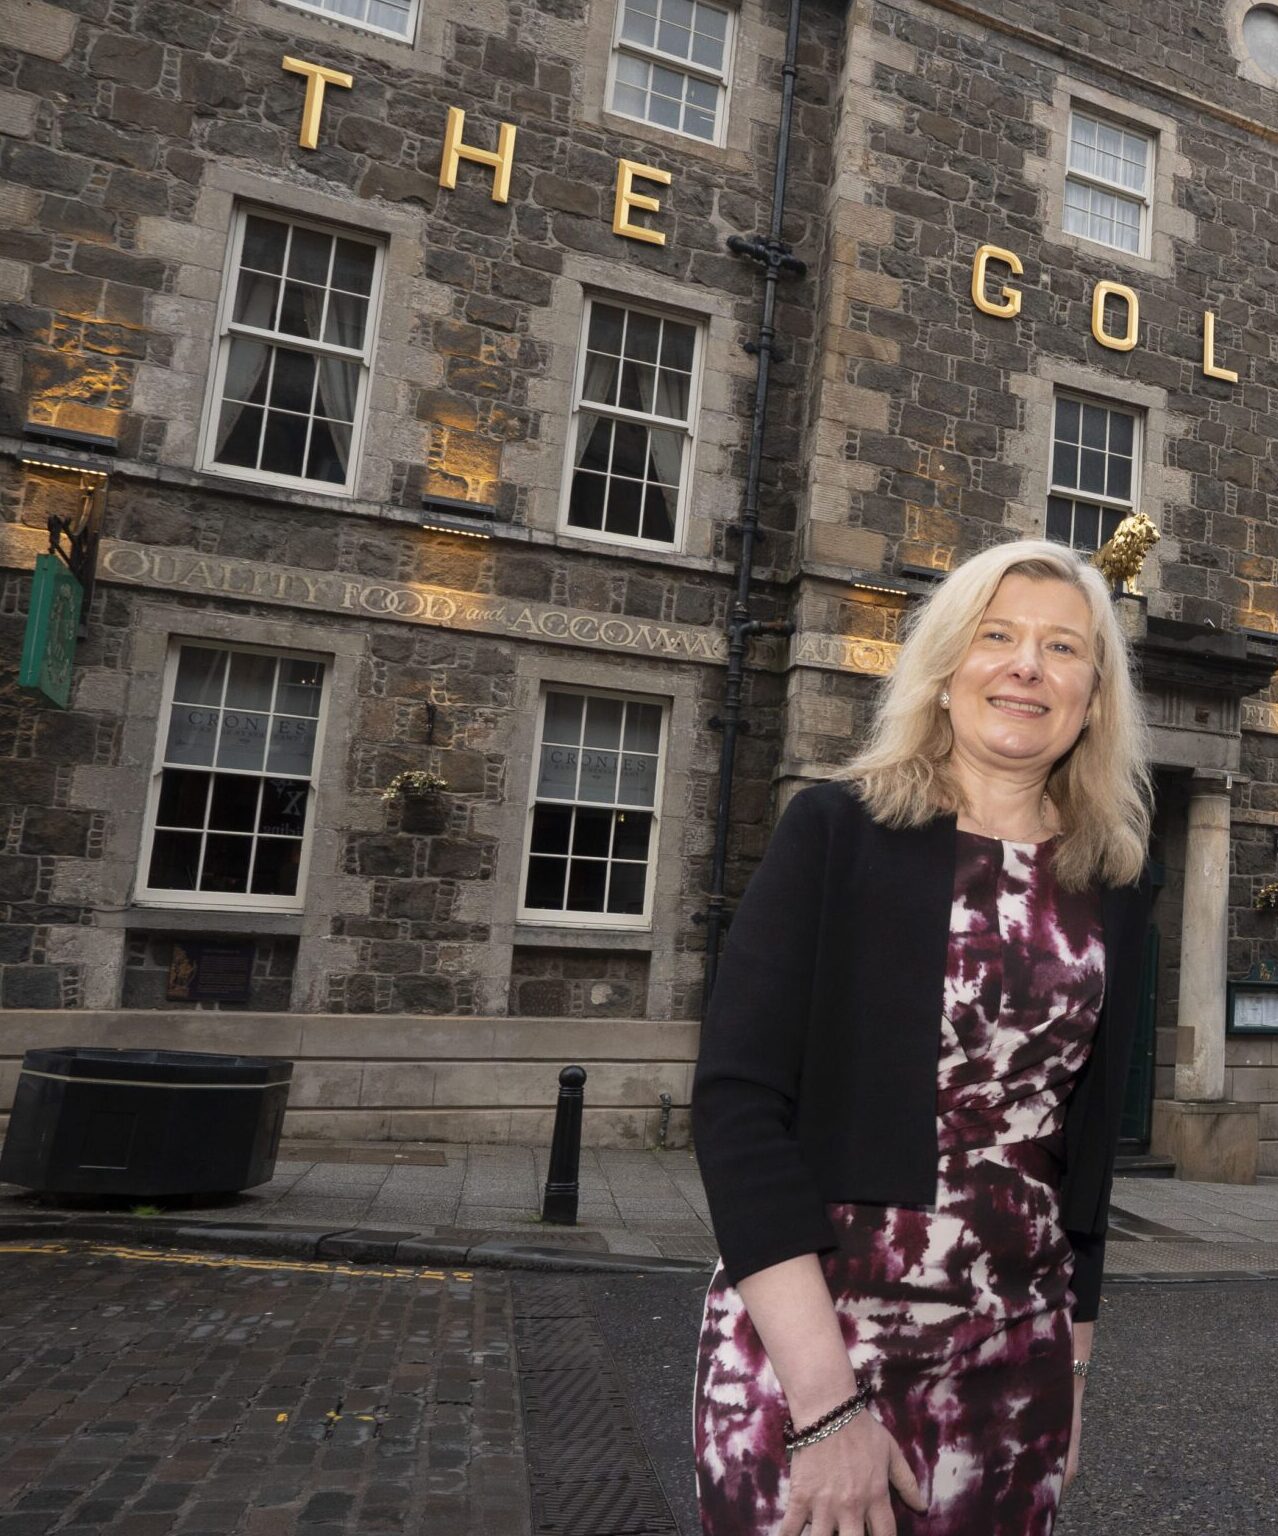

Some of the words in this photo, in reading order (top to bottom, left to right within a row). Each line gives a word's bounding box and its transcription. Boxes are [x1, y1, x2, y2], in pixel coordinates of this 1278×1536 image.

[281, 55, 672, 246] THE
[103, 548, 326, 603] QUALITY
[340, 581, 456, 621] FOOD
[466, 606, 506, 621] and
[188, 710, 306, 736] CRONES
